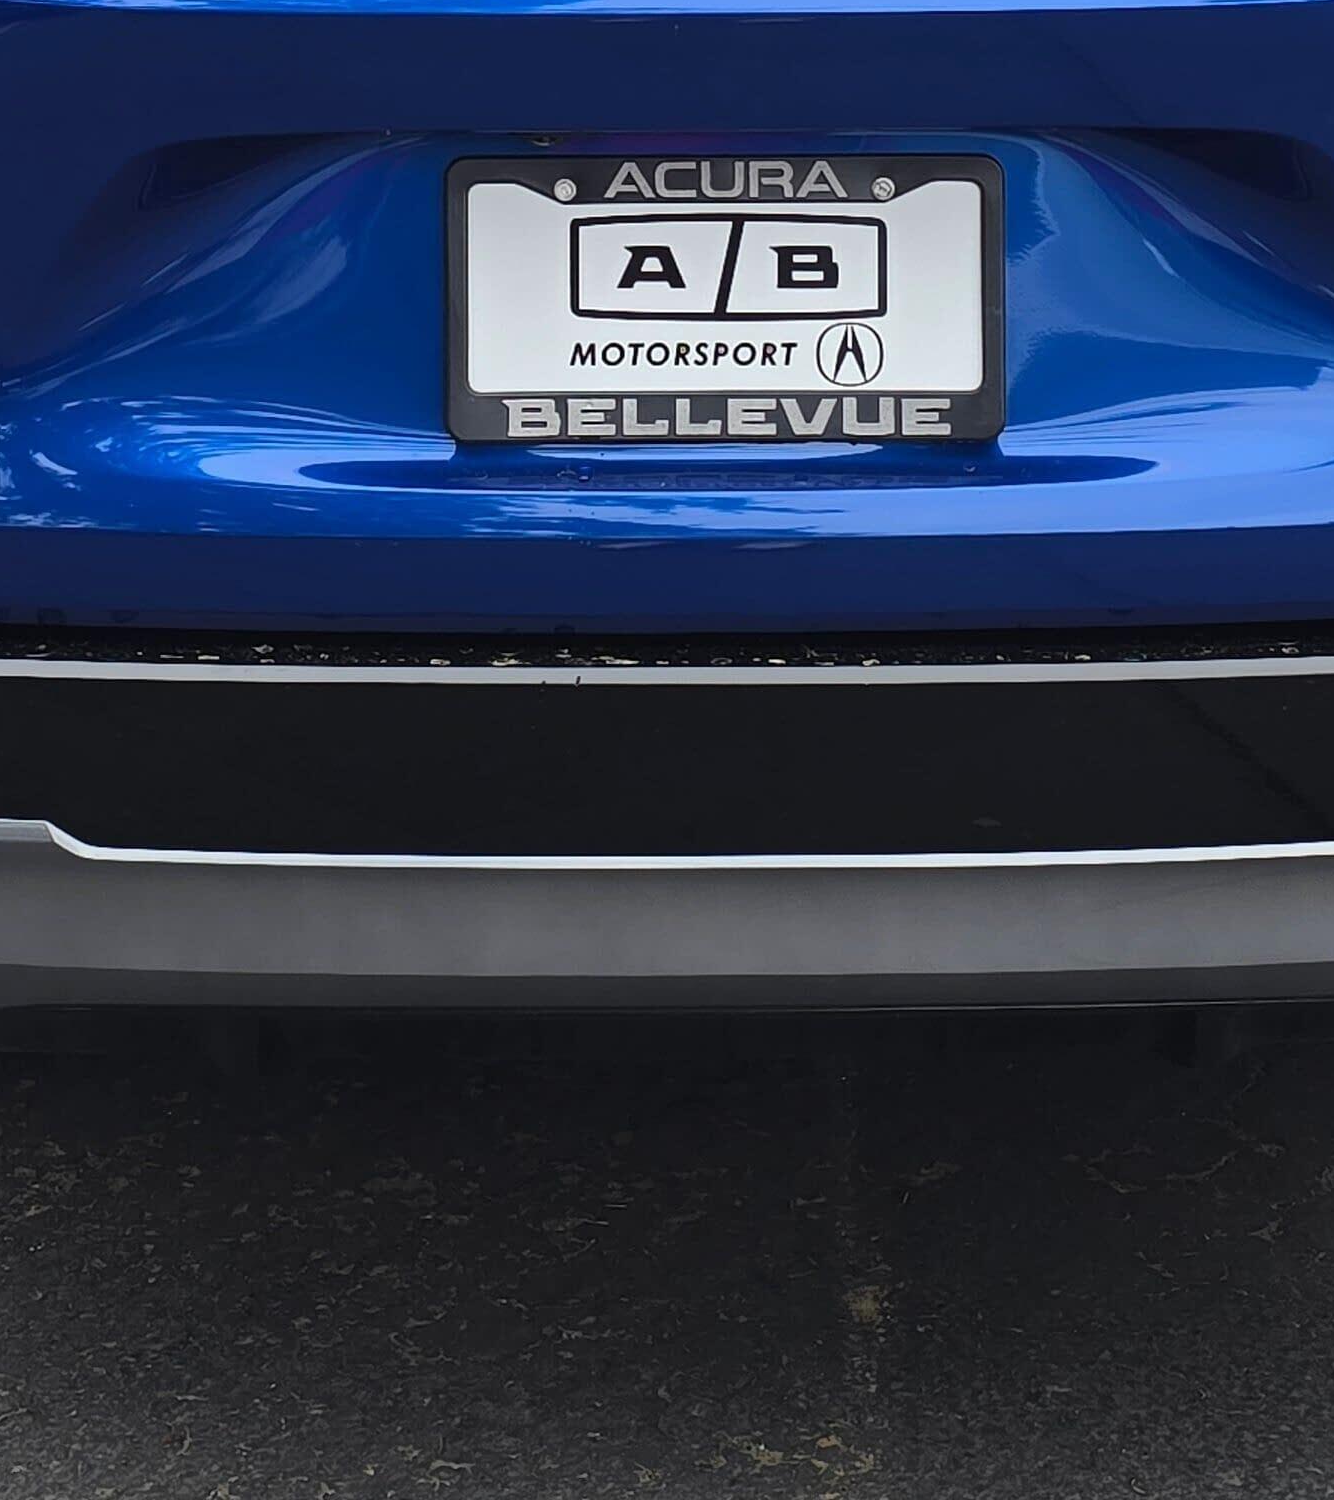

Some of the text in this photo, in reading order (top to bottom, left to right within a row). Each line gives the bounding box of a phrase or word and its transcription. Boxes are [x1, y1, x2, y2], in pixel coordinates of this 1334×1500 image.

[603, 160, 849, 199] ACURA
[616, 245, 839, 289] A B
[569, 341, 798, 367] MOTORSPORT
[501, 398, 953, 438] BELLEVUE
